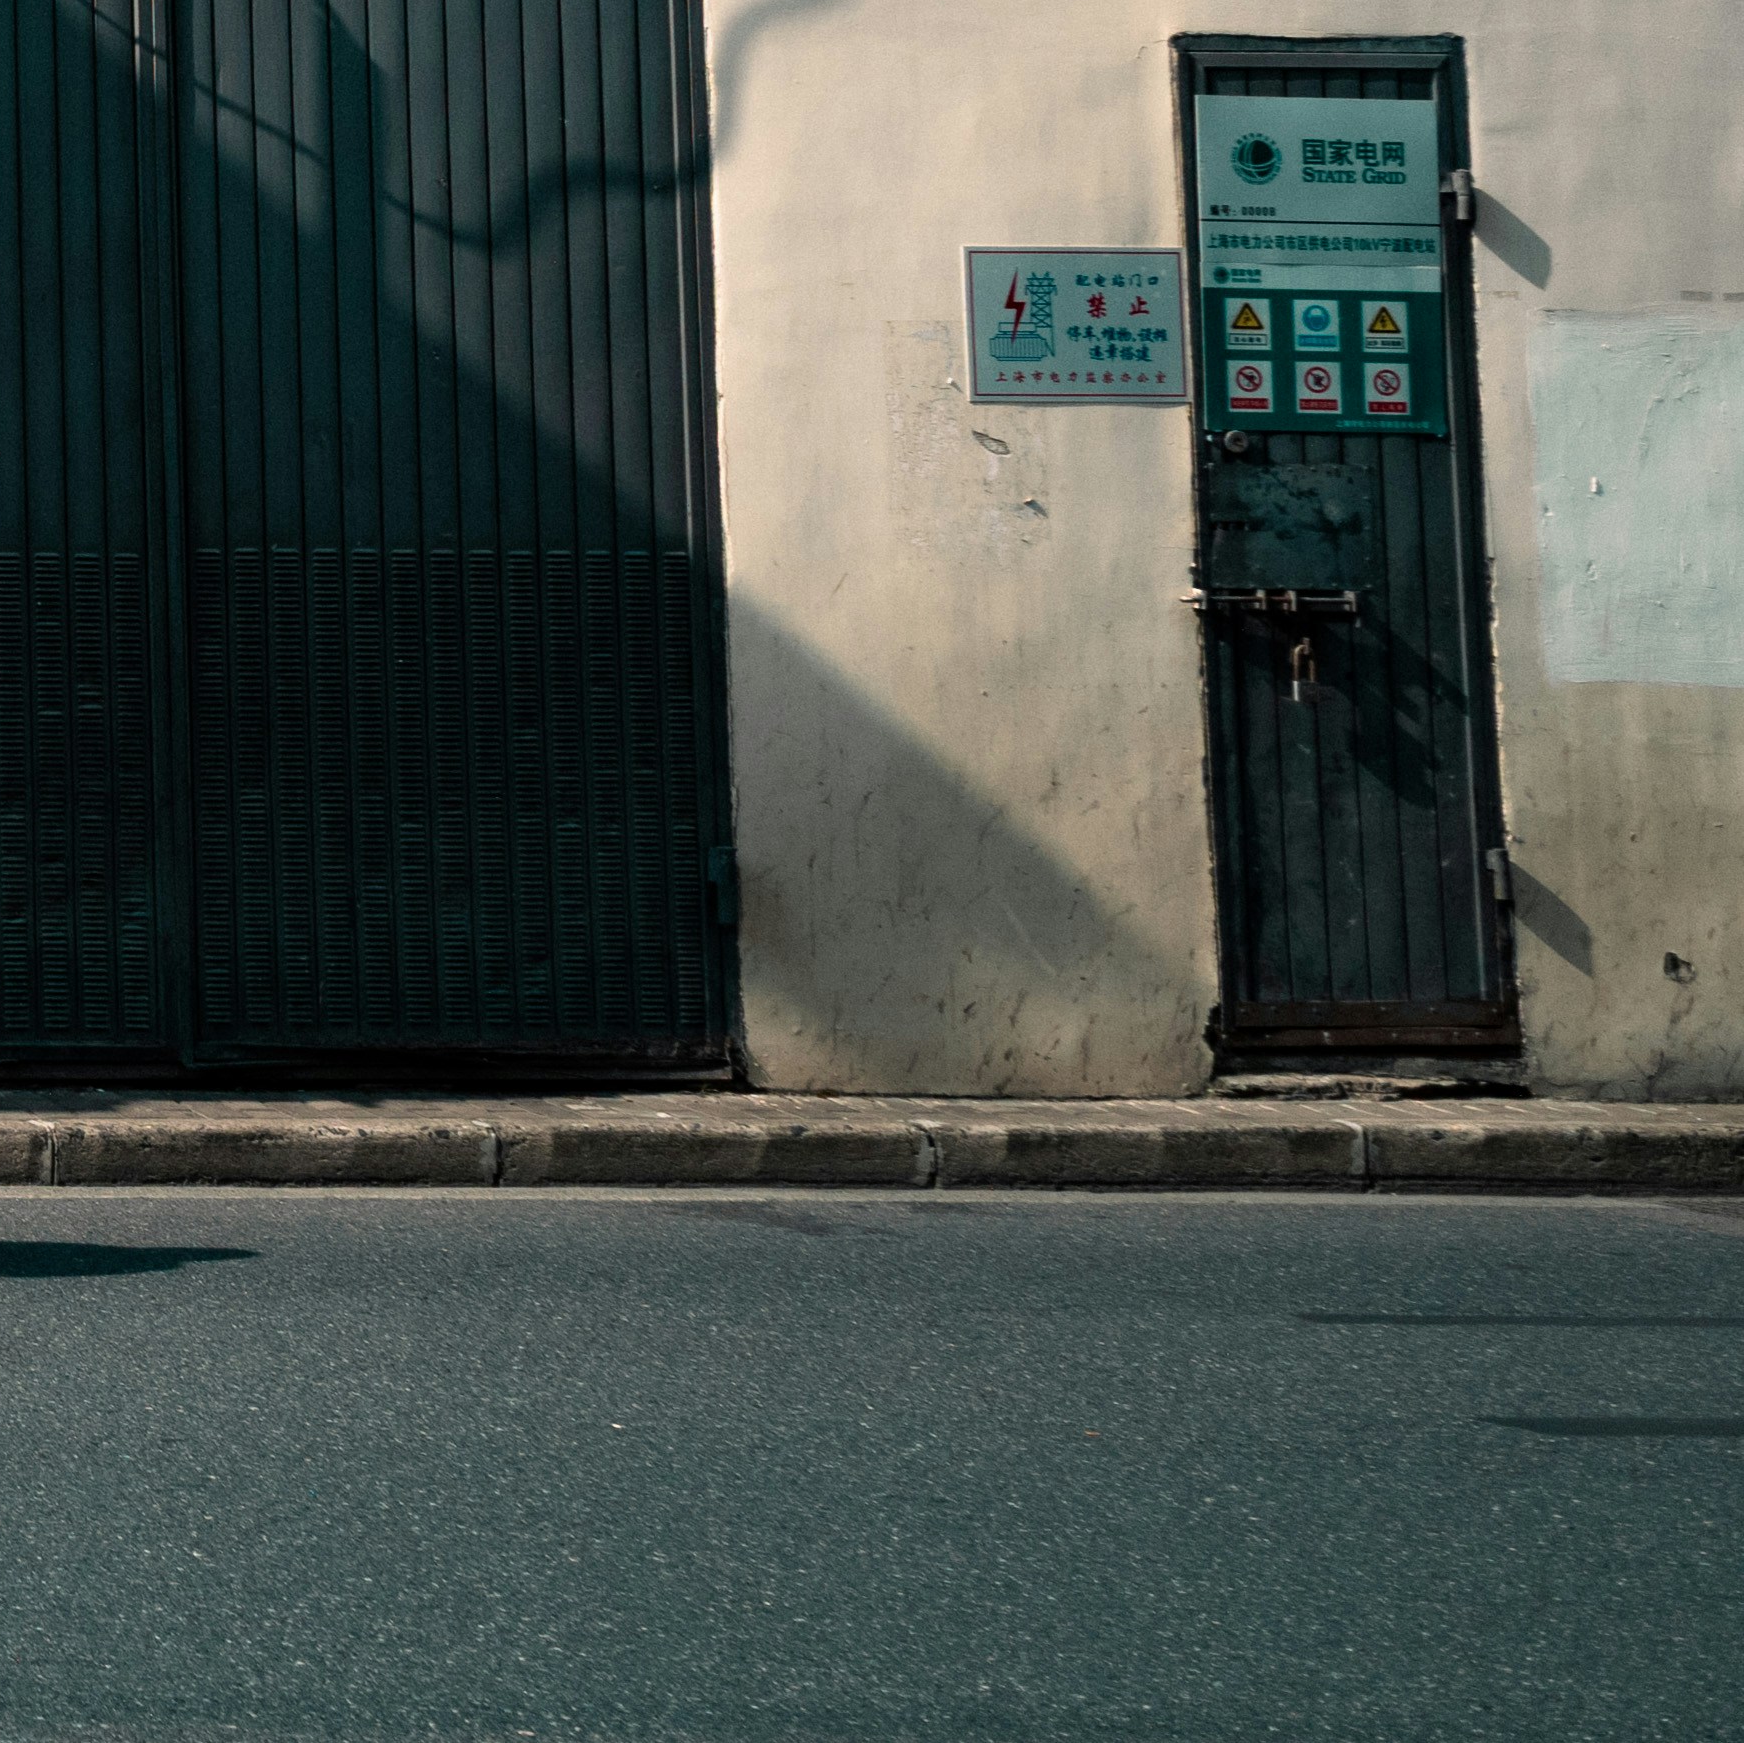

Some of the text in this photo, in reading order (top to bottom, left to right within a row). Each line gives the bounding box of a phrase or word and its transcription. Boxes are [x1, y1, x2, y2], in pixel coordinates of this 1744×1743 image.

[1302, 139, 1405, 167] 国家电网
[1302, 167, 1406, 184] STATE GRID
[1075, 274, 1159, 287] 配电站门口
[1087, 292, 1150, 318] 禁止
[1089, 343, 1152, 362] 违章搭建
